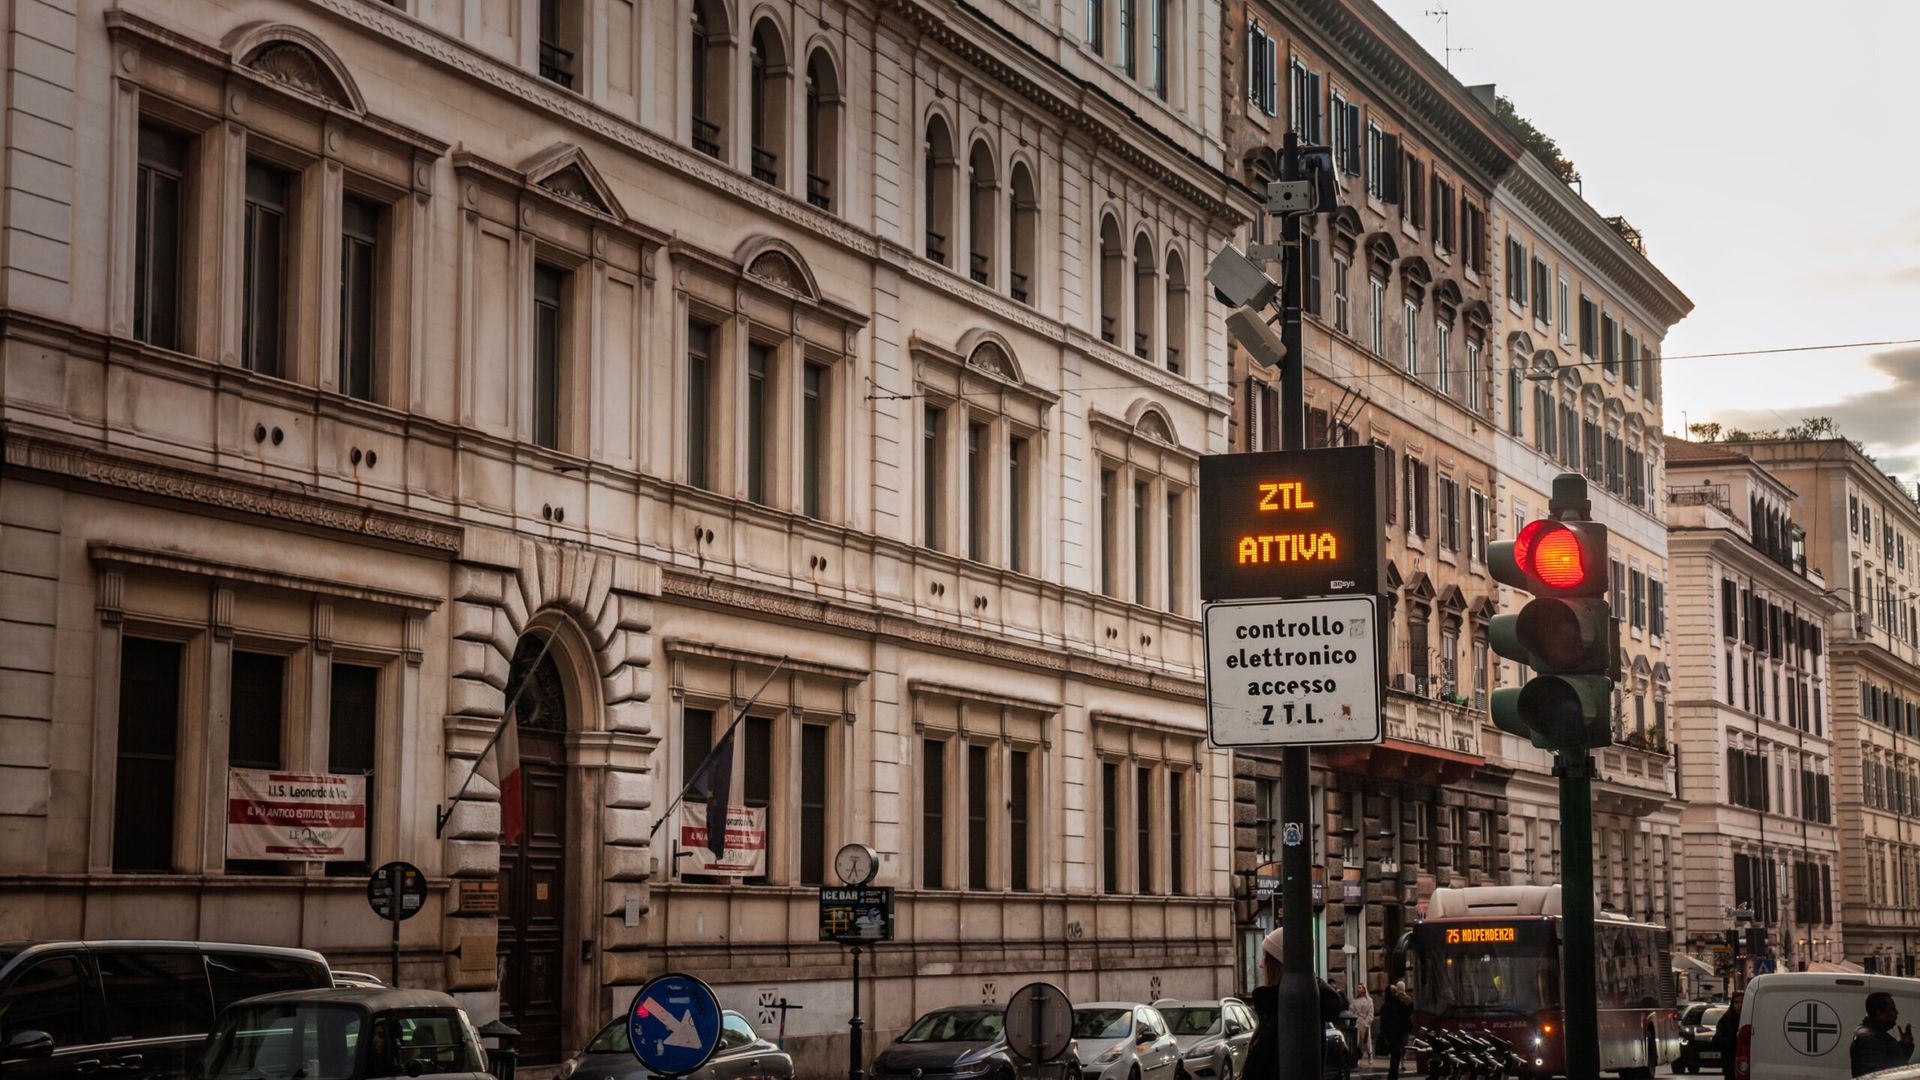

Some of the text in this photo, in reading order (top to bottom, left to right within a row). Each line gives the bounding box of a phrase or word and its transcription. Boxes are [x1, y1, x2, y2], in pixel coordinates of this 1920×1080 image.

[1259, 482, 1314, 511] ZTL
[1238, 532, 1337, 564] ATTIVA
[1235, 615, 1345, 640] controllo
[1225, 644, 1358, 669] elettronico
[1247, 678, 1337, 696] accesso
[266, 807, 295, 819] ANTICO
[822, 889, 838, 901] ICE
[839, 889, 859, 901] BAR
[1446, 929, 1460, 944] 75
